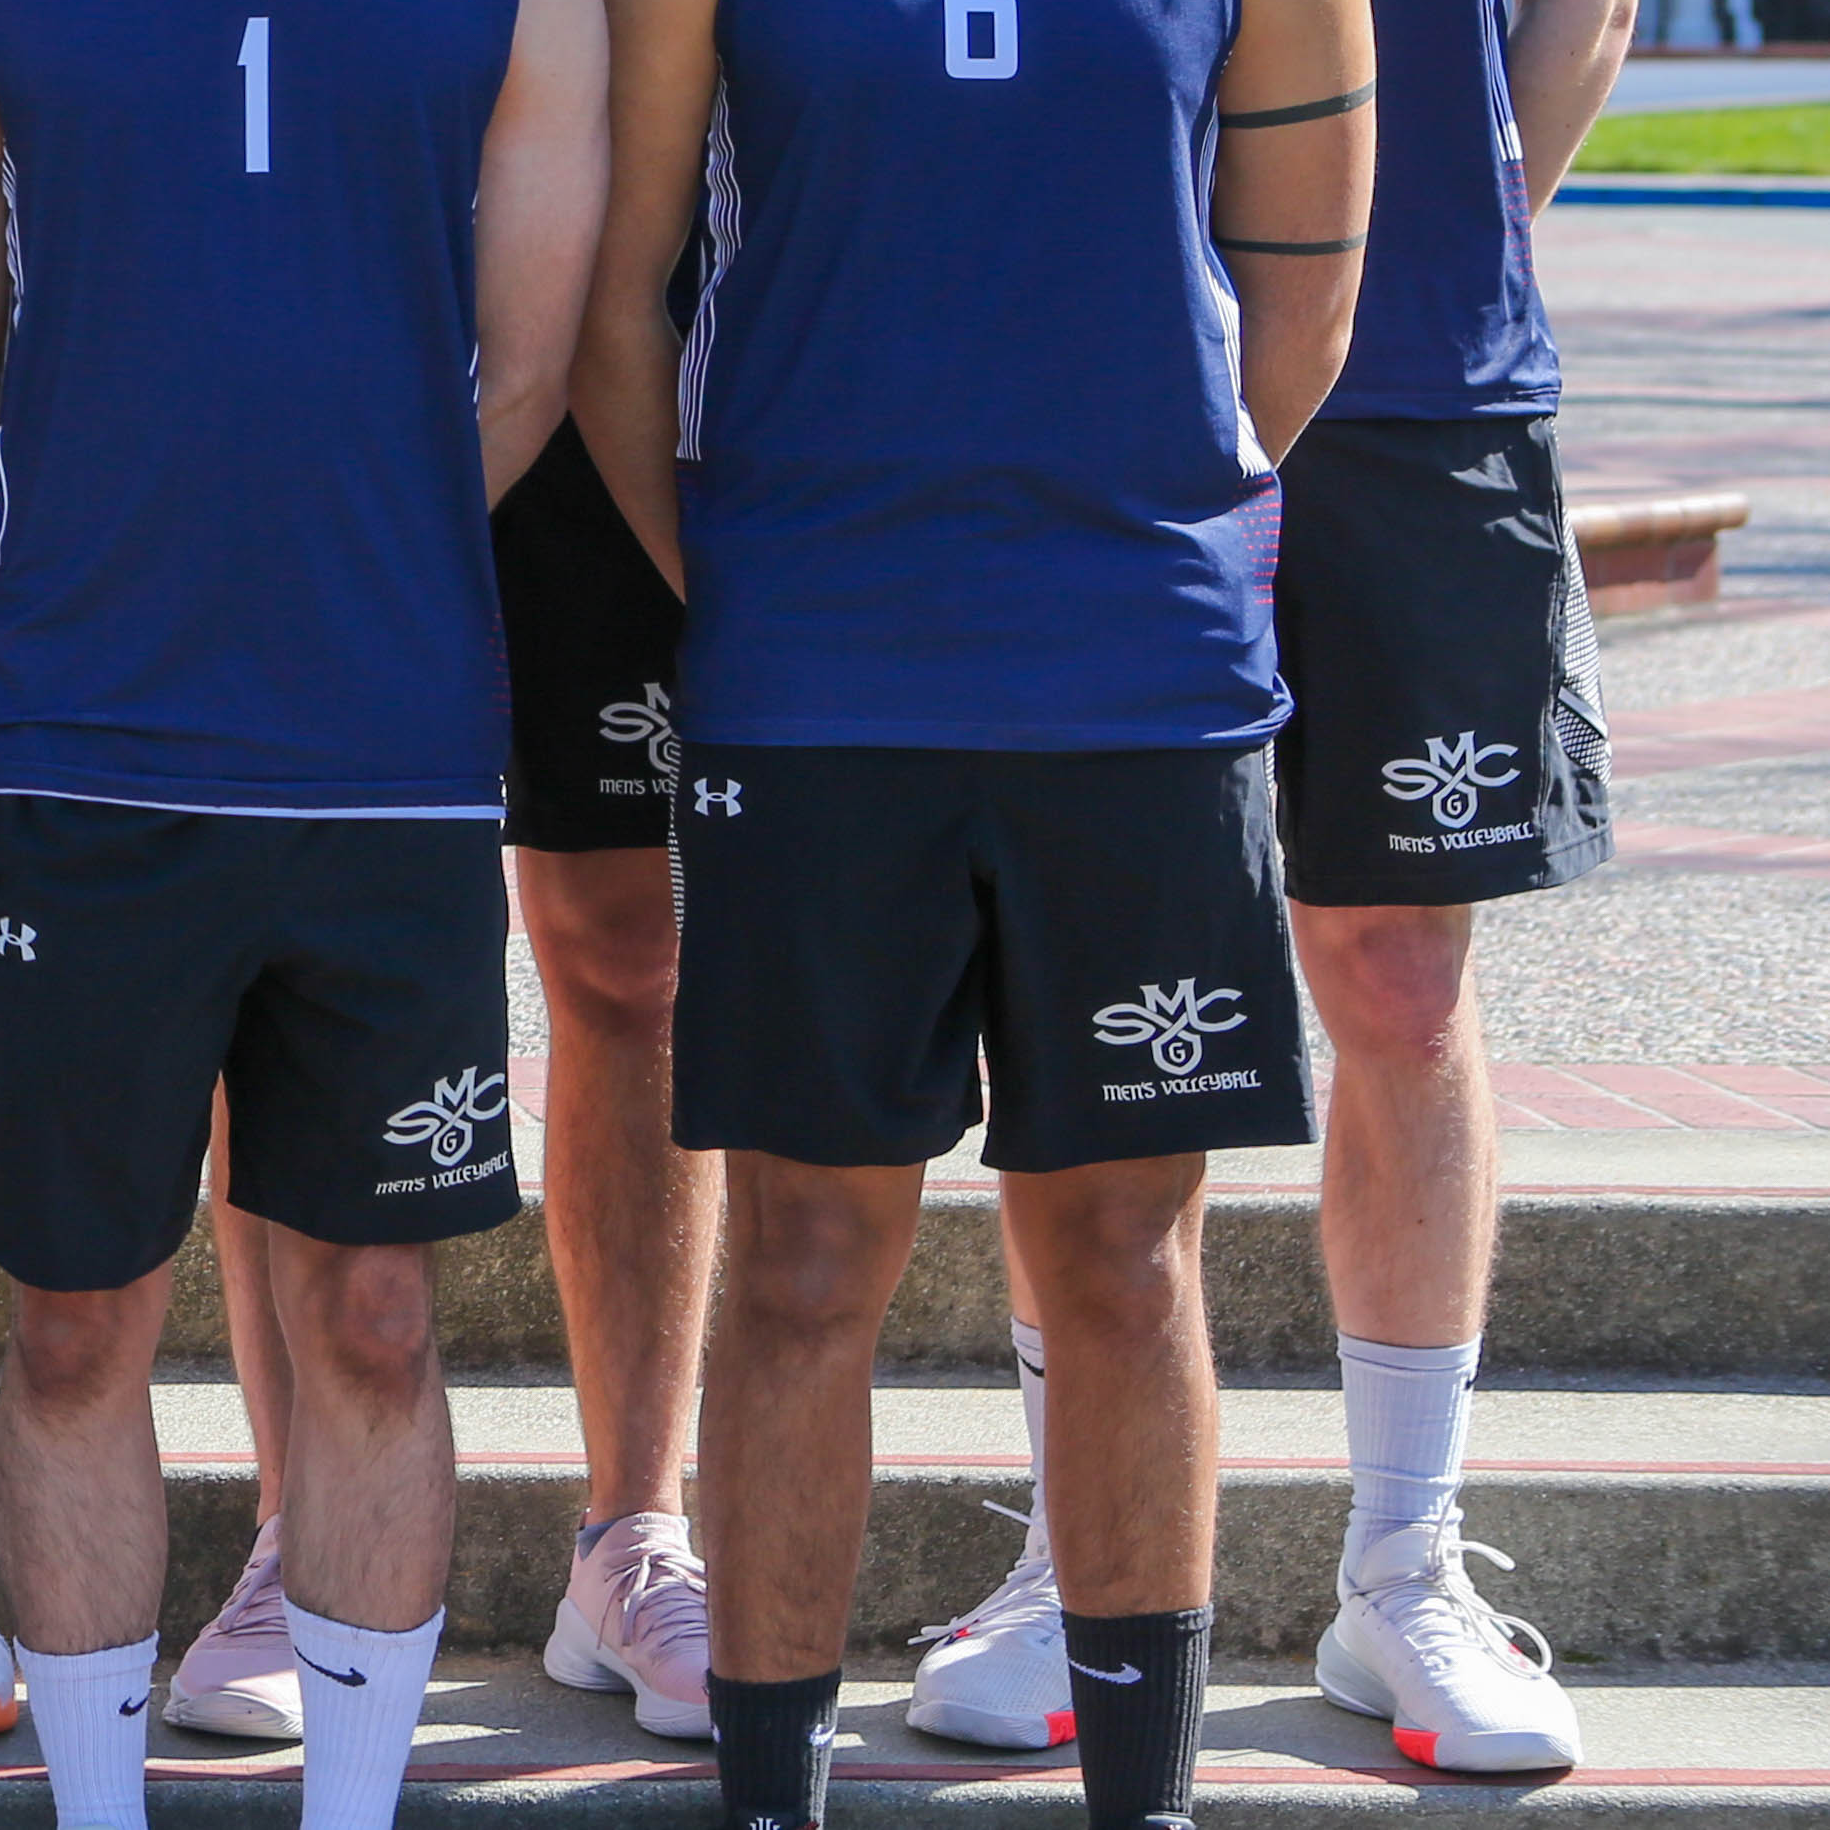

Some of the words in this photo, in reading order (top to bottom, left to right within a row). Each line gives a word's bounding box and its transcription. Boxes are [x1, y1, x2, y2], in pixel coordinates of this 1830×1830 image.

[237, 16, 270, 173] 1
[599, 778, 646, 795] MEN'S
[1388, 833, 1436, 854] MEN'S
[1440, 821, 1534, 851] VOLLEYBALL
[1102, 1082, 1157, 1101] MEN'S
[1160, 1069, 1262, 1095] VOLLEYBALL
[375, 1177, 426, 1195] MEN'S
[432, 1151, 509, 1189] VOLLEYBALL
